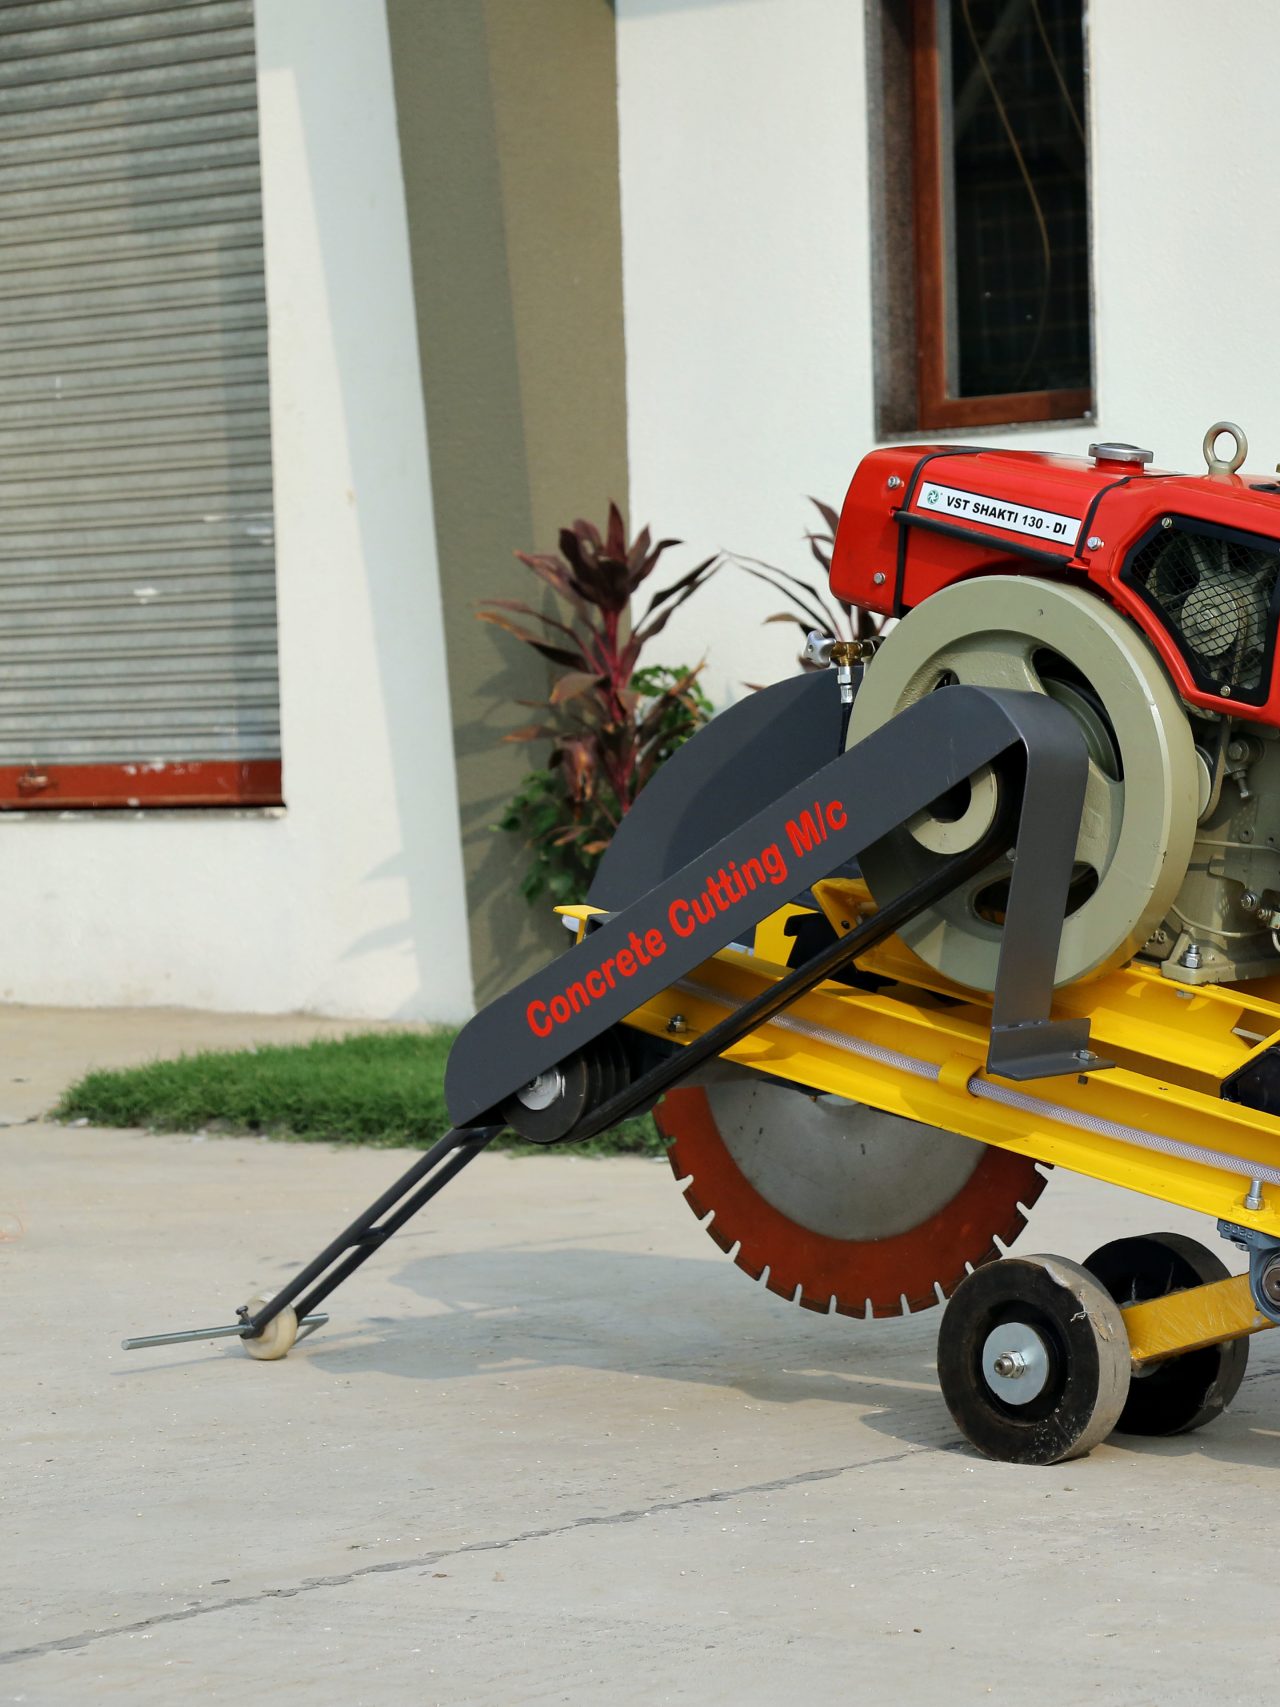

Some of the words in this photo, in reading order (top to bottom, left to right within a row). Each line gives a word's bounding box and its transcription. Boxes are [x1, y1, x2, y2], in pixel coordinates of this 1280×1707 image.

[946, 495, 970, 511] VST
[972, 502, 1018, 523] SHAKTI
[1022, 515, 1043, 529] 130
[1053, 522, 1067, 535] DI
[526, 927, 667, 1038] Concrete
[668, 843, 789, 938] Cutting
[785, 799, 848, 858] M/c
